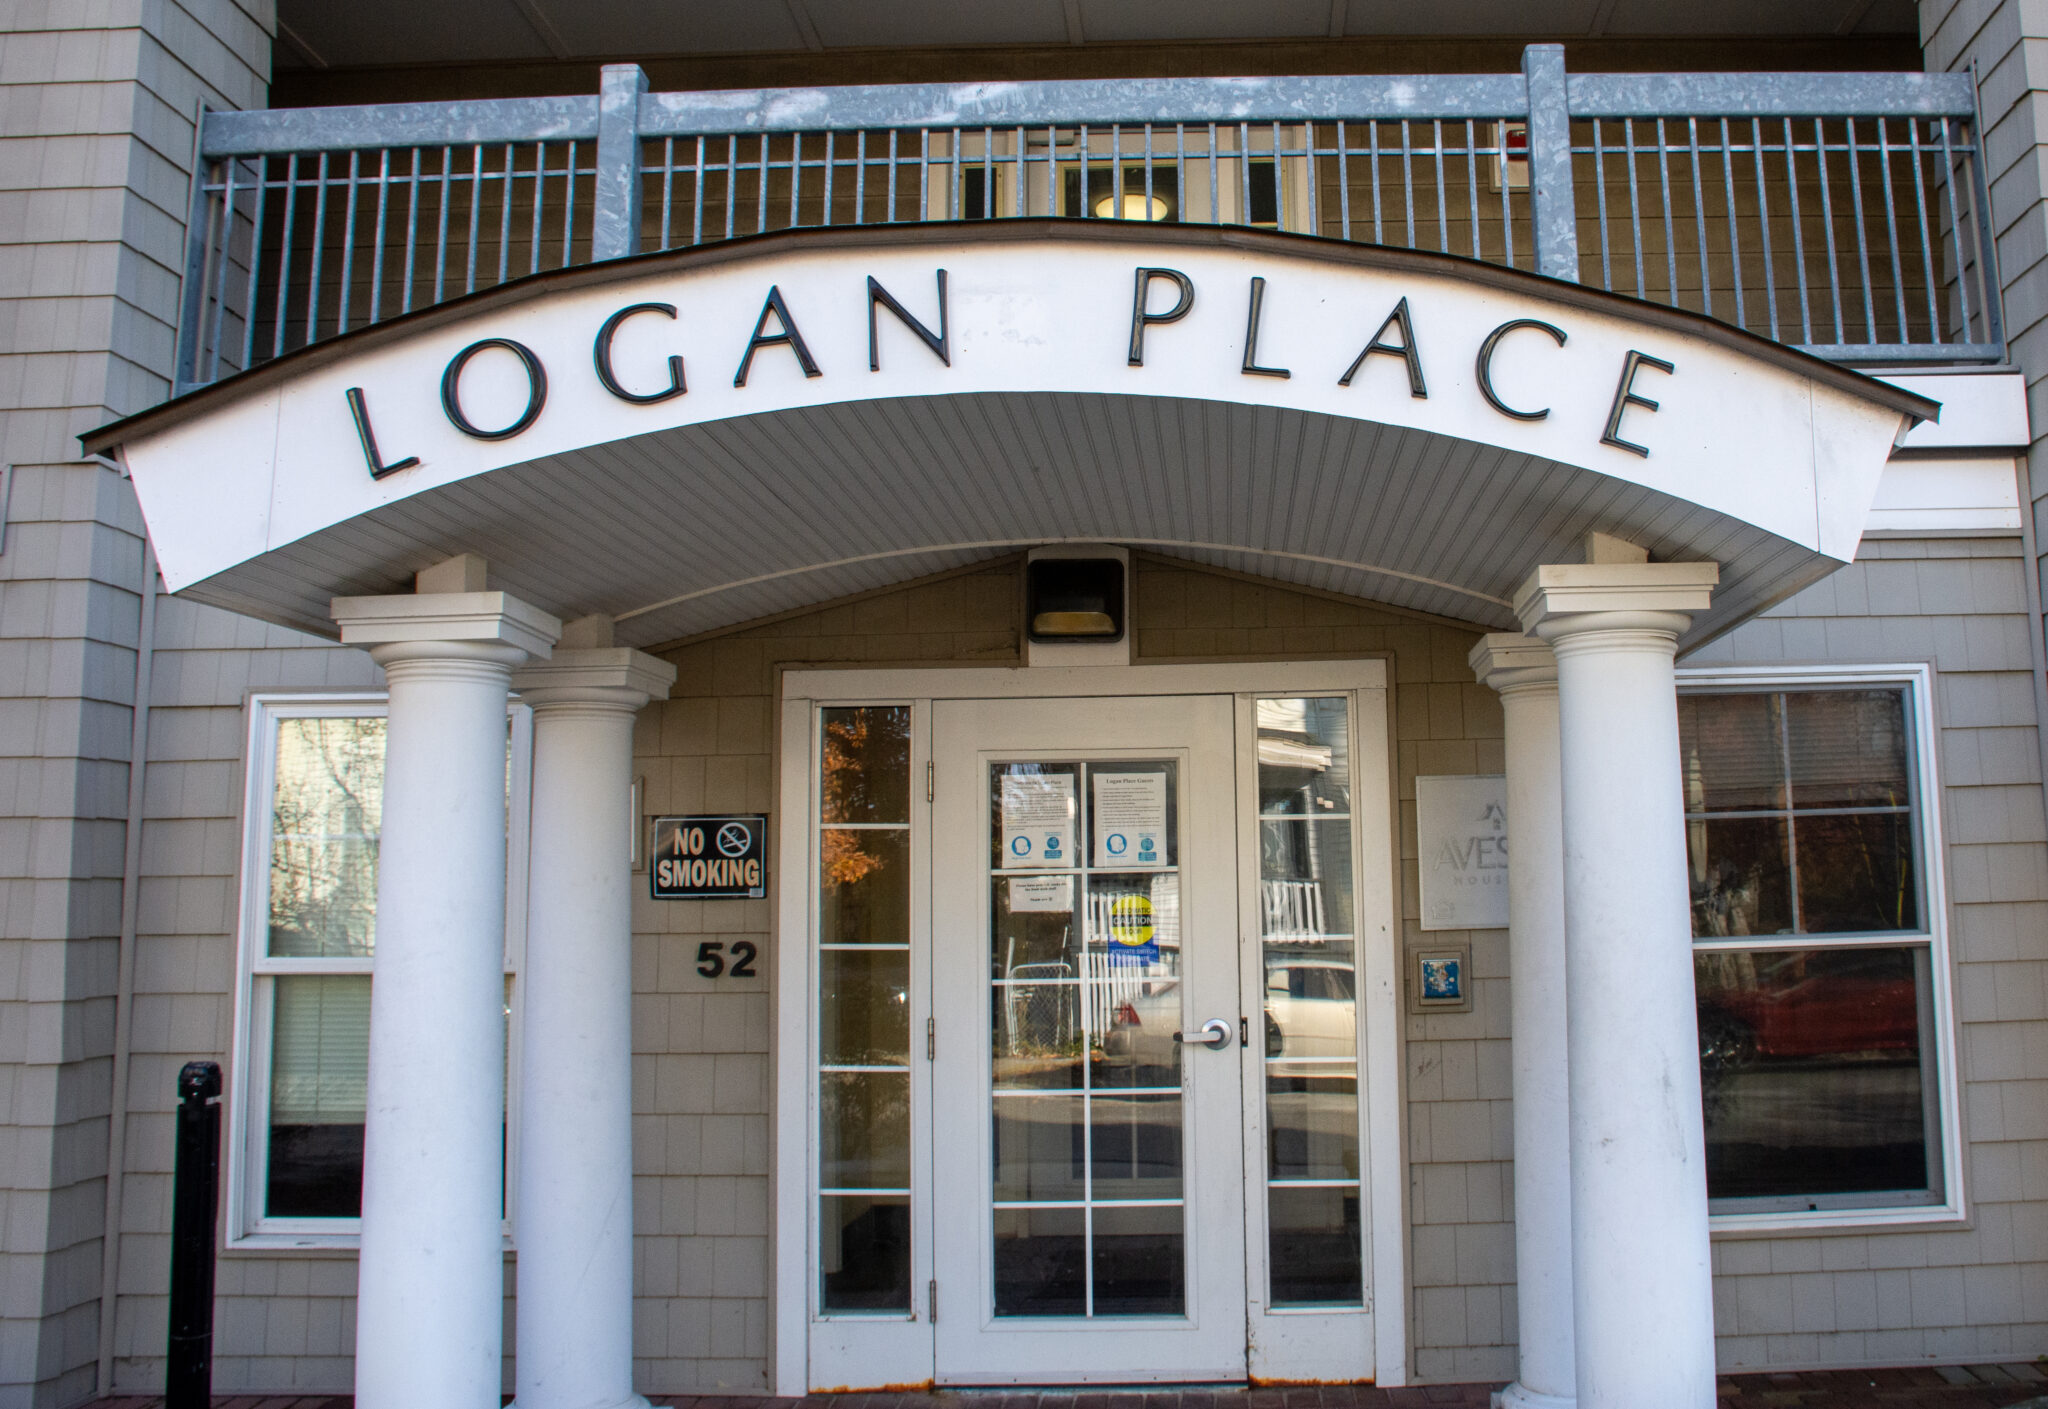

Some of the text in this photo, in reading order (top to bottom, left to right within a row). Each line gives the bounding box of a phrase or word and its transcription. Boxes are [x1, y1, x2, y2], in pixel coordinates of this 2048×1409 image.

[345, 267, 1675, 481] LOGAN PLACE
[673, 827, 705, 856] NO
[658, 858, 760, 888] SMOKING
[1113, 916, 1153, 926] CAUTION
[696, 941, 757, 979] 52
